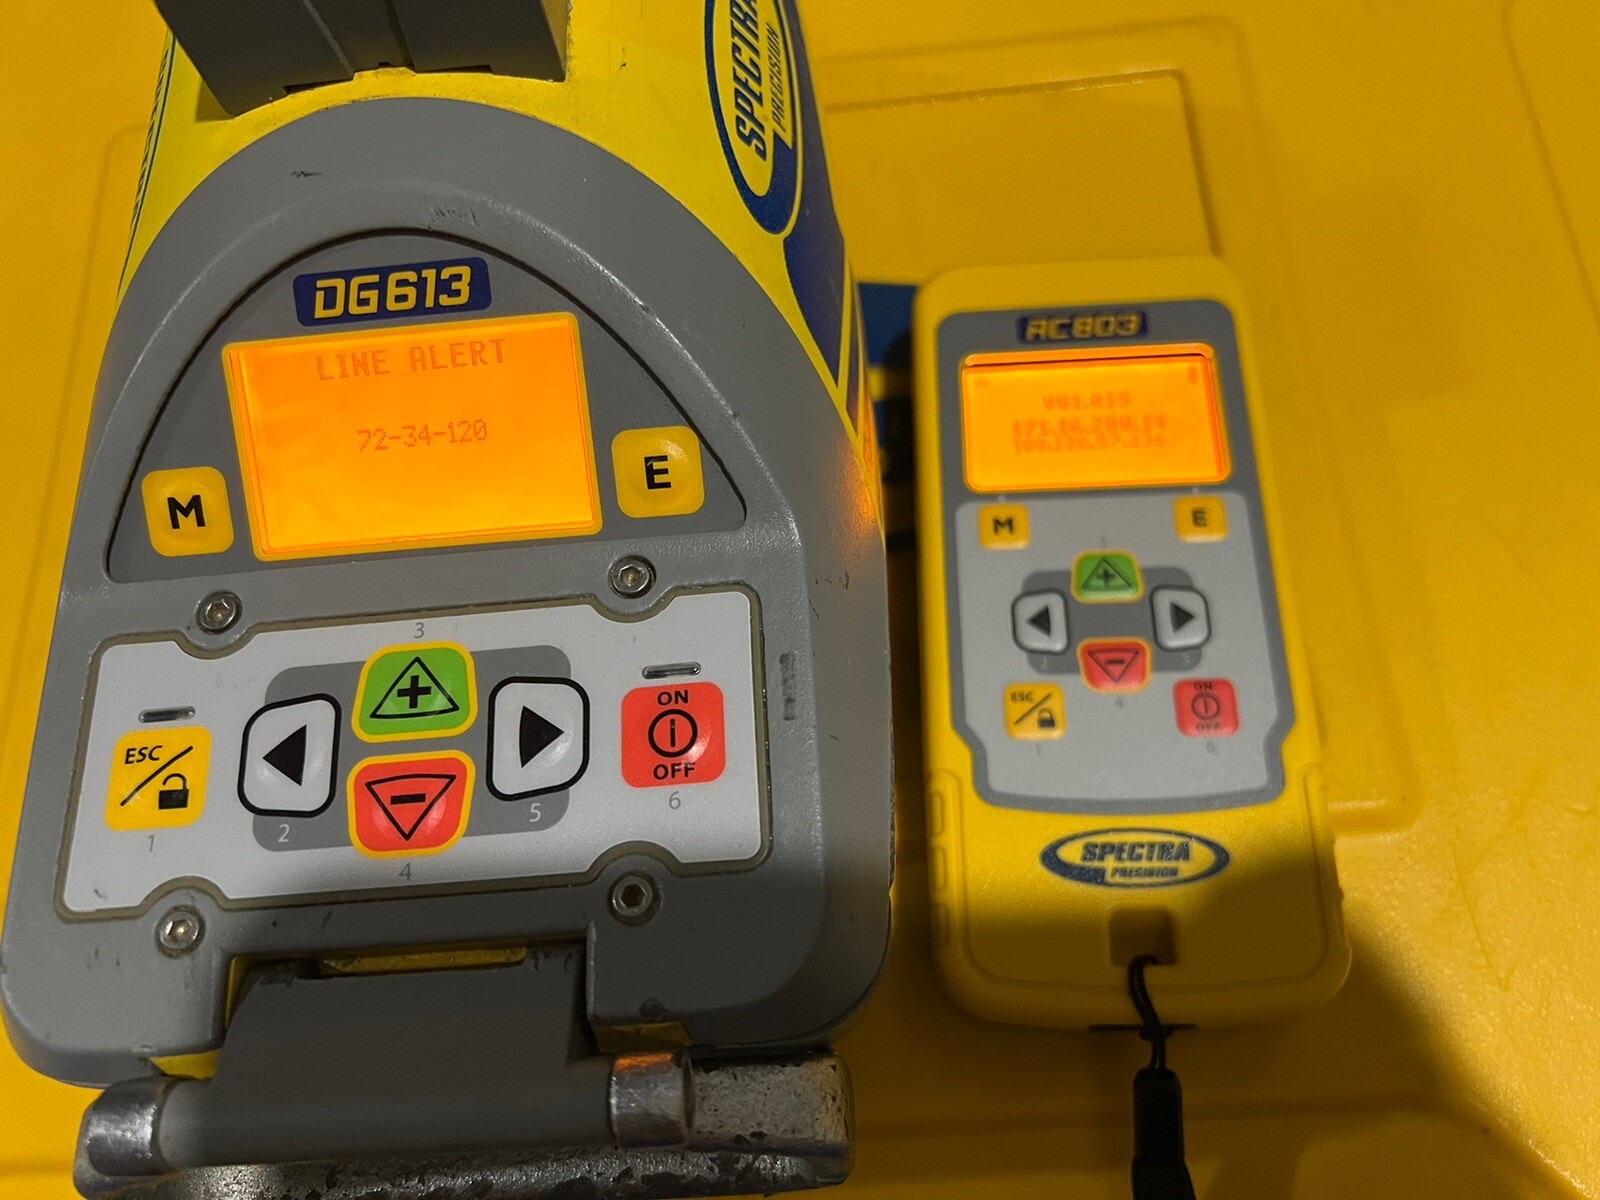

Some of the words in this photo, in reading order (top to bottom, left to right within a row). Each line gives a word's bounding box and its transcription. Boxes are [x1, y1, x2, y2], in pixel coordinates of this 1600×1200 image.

[766, 21, 786, 133] PRECISION
[314, 265, 472, 320] DG613
[1025, 312, 1142, 342] AC803
[315, 349, 390, 381] LINE
[409, 338, 507, 373] ALERT
[357, 419, 488, 452] 72-34-120
[644, 454, 672, 491] E
[167, 494, 206, 530] M
[1191, 508, 1208, 528] E
[992, 517, 1015, 536] M
[414, 622, 425, 639] 3
[1194, 682, 1213, 692] ON
[657, 689, 689, 706] ON
[1010, 691, 1034, 703] ESC
[1195, 722, 1221, 731] OFF
[124, 744, 164, 765] ESC
[653, 762, 696, 781] OFF
[669, 791, 681, 810] 6
[529, 803, 542, 822] 5
[277, 823, 290, 843] 2
[147, 835, 155, 852] 1
[1082, 841, 1191, 862] SPECTRA
[398, 863, 412, 881] 4
